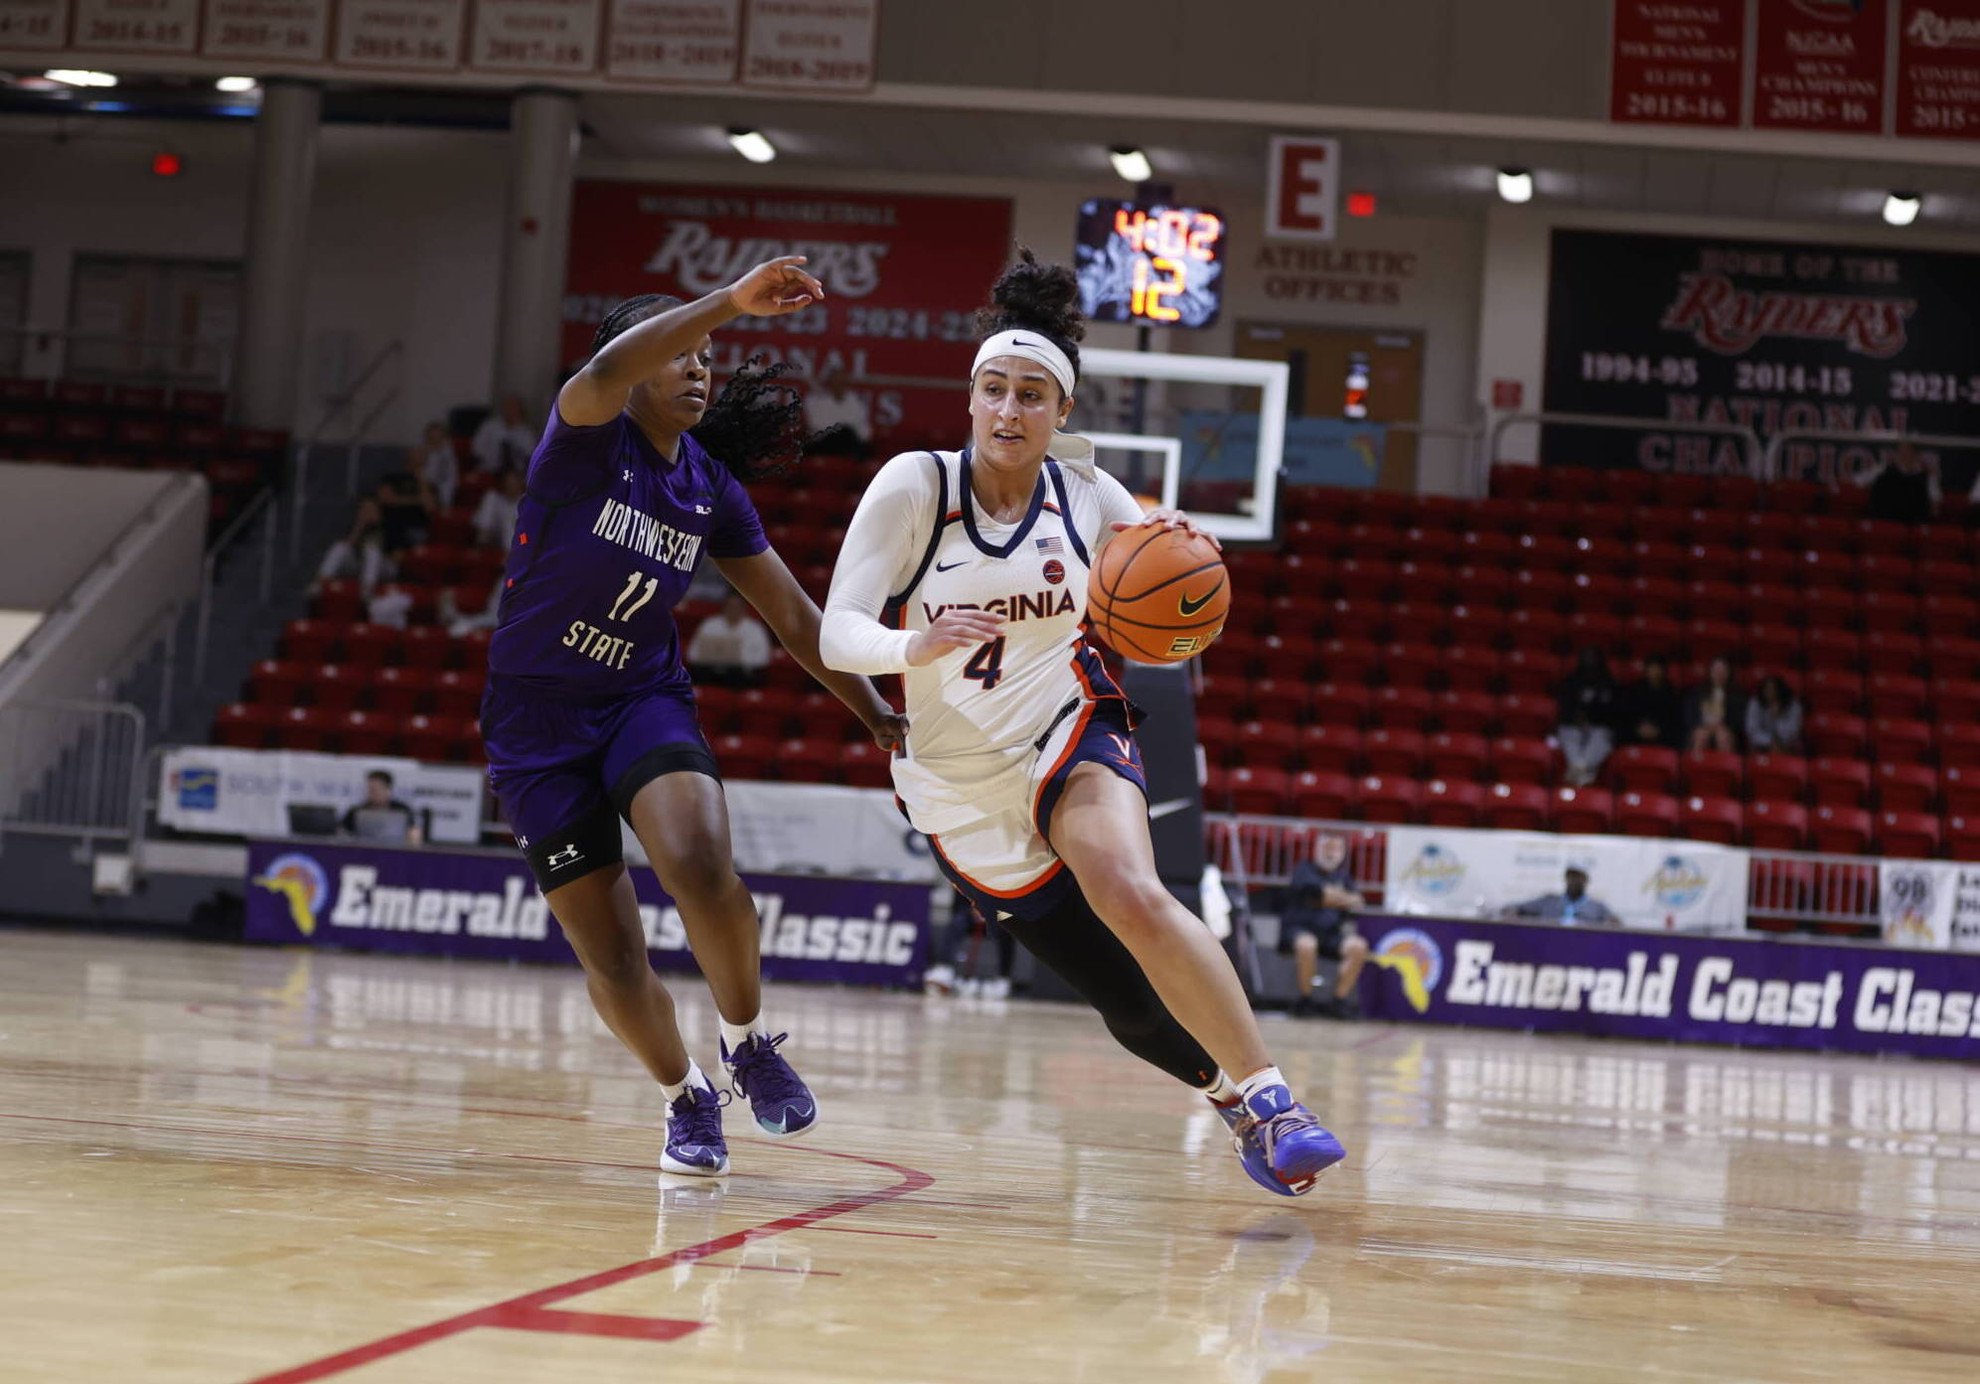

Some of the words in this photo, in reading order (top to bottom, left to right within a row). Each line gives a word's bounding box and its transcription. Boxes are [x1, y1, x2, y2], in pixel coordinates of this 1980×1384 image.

[1278, 144, 1327, 231] E
[1115, 209, 1221, 262] 4:02
[1253, 245, 1417, 278] ATHLETIC
[1131, 256, 1187, 322] 12
[1263, 274, 1400, 305] OFFICES
[1735, 361, 1852, 395] 2014-15
[1666, 395, 1909, 437] NATIONAL
[591, 498, 703, 573] NORTHWESTERN
[607, 570, 659, 622] 11
[922, 587, 1076, 625] VGINIA
[562, 620, 634, 670] STATE
[962, 635, 1007, 691] 4
[329, 864, 550, 941] Emerald
[750, 893, 918, 967] lassic
[1446, 939, 1678, 1019] Emerald
[1689, 957, 1843, 1028] Coast
